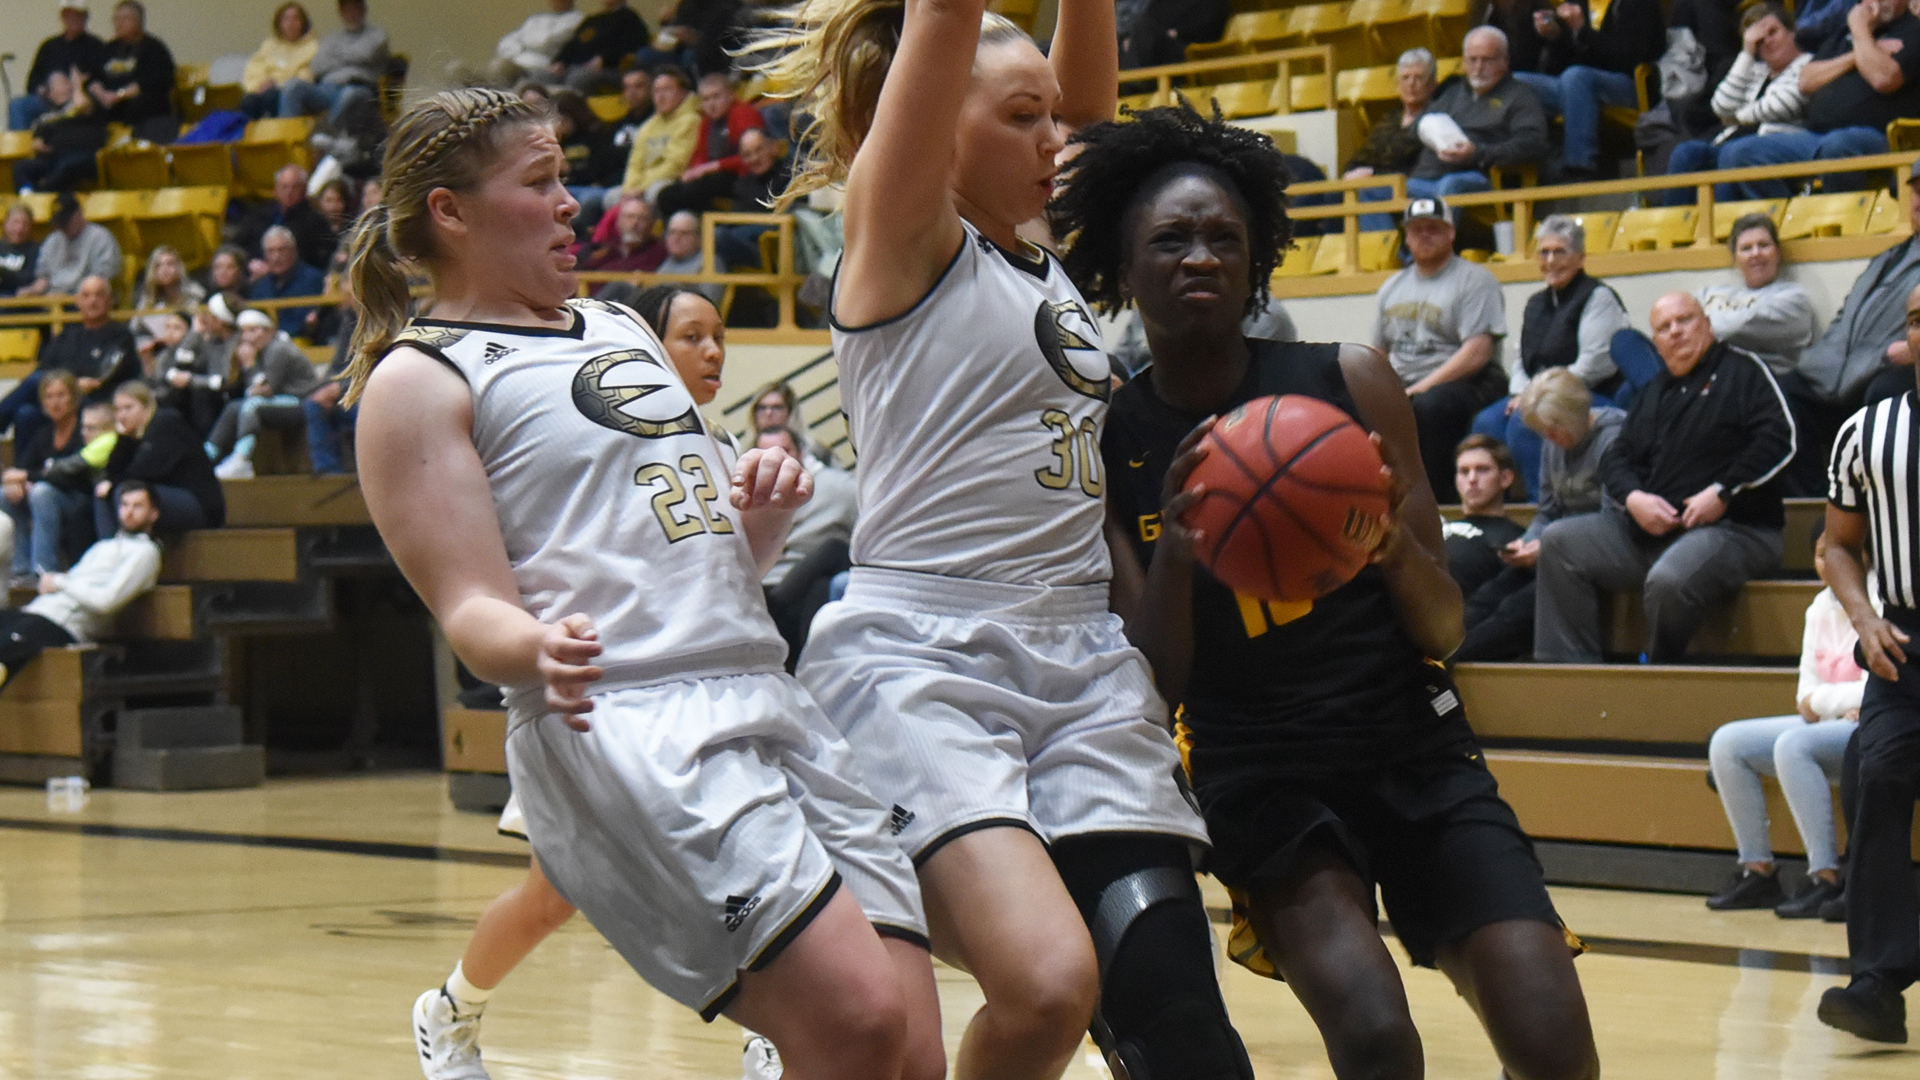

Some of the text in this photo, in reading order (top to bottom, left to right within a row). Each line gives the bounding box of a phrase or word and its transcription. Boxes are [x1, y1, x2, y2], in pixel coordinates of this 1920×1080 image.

[634, 453, 735, 544] 22
[1034, 408, 1101, 499] 30
[727, 895, 762, 932] adidas
